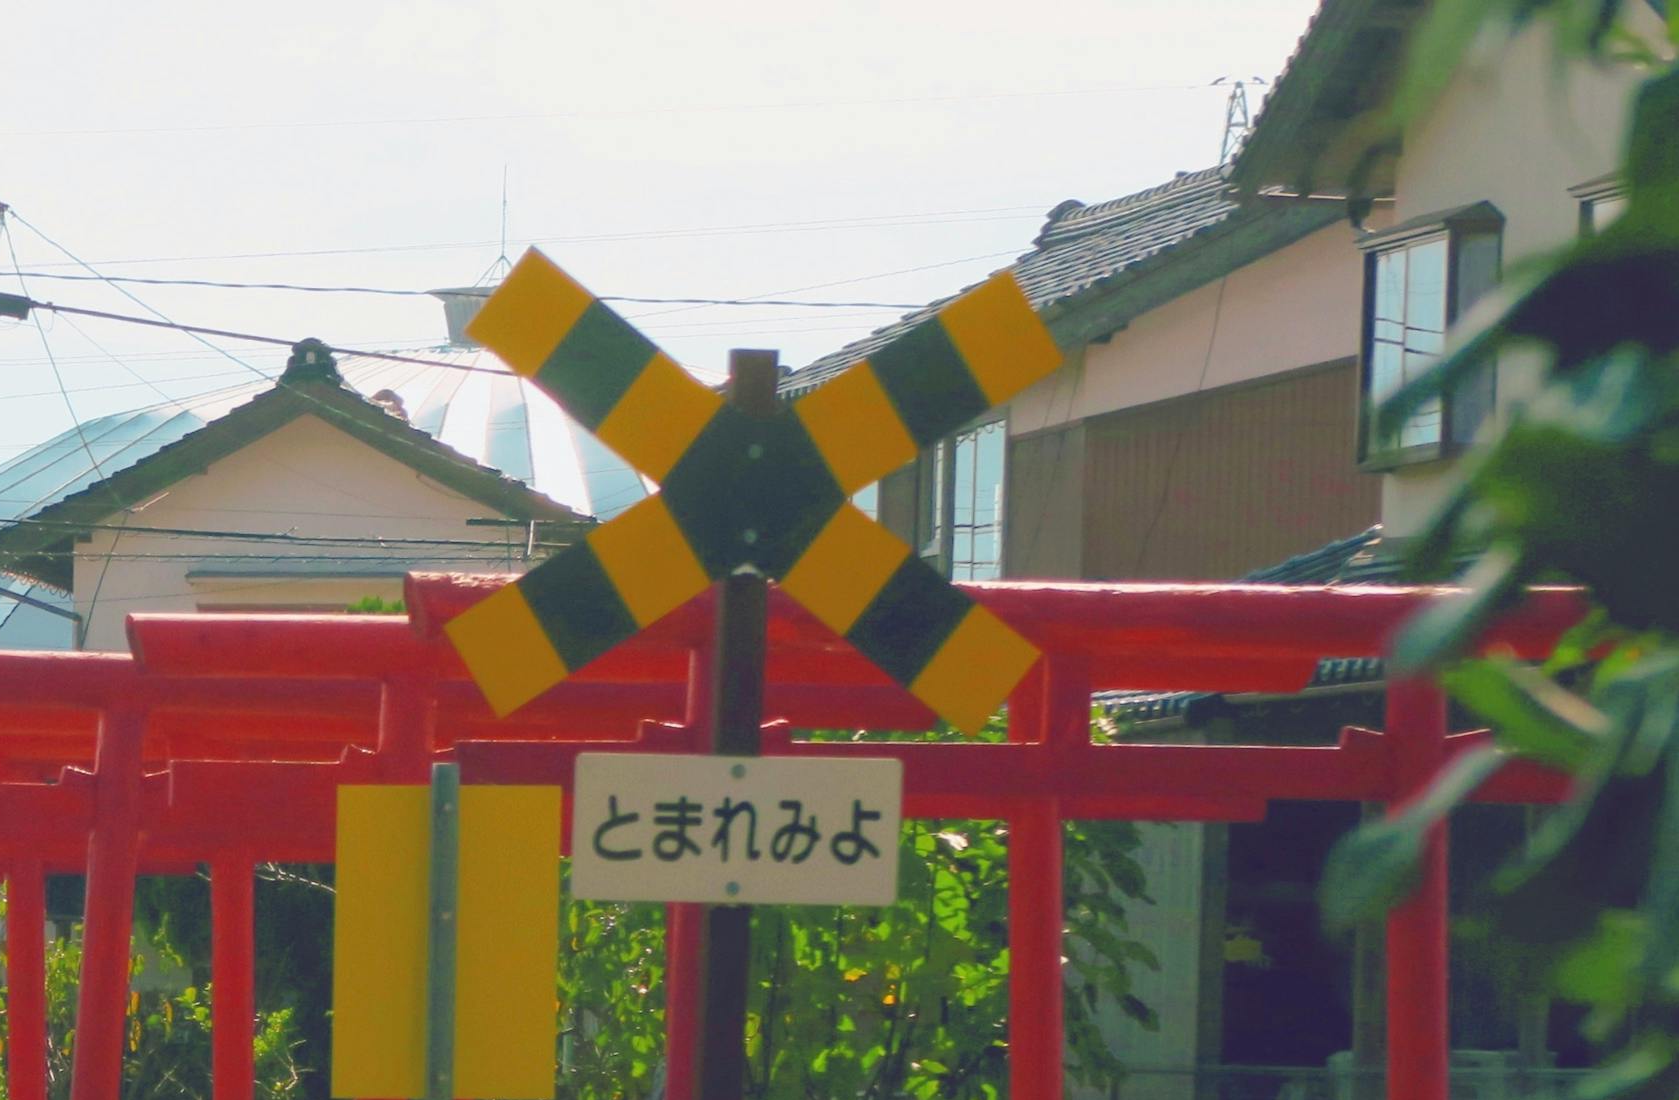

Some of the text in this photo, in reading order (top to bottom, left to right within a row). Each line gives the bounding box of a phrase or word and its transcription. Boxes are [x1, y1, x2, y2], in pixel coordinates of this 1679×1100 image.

[592, 794, 883, 866] とまれみよ
